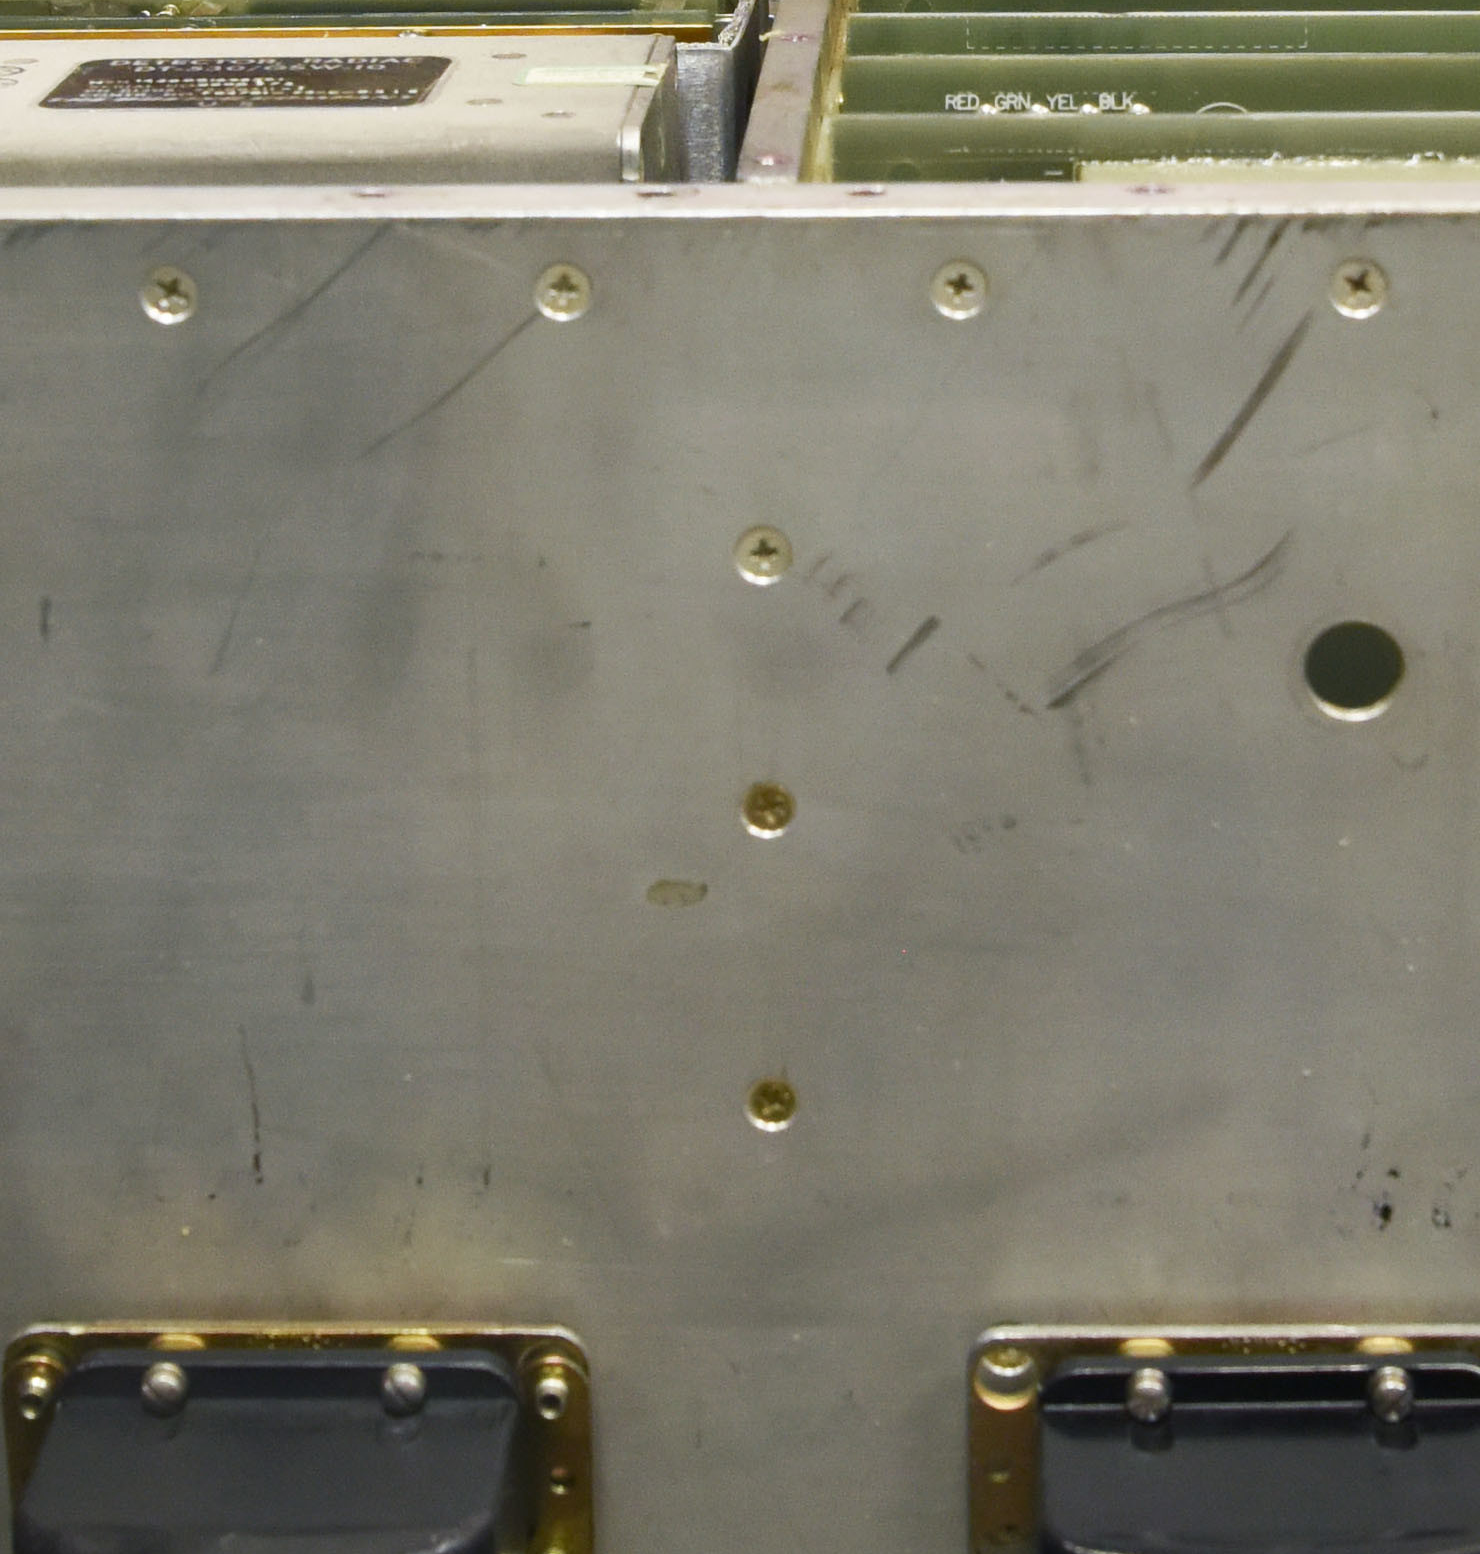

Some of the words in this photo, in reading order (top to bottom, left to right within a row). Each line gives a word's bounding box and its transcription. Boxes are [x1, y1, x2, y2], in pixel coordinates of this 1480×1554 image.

[945, 94, 980, 111] RED
[994, 93, 1031, 111] GRN
[1046, 94, 1078, 111] YEL
[1098, 93, 1134, 111] BLK
